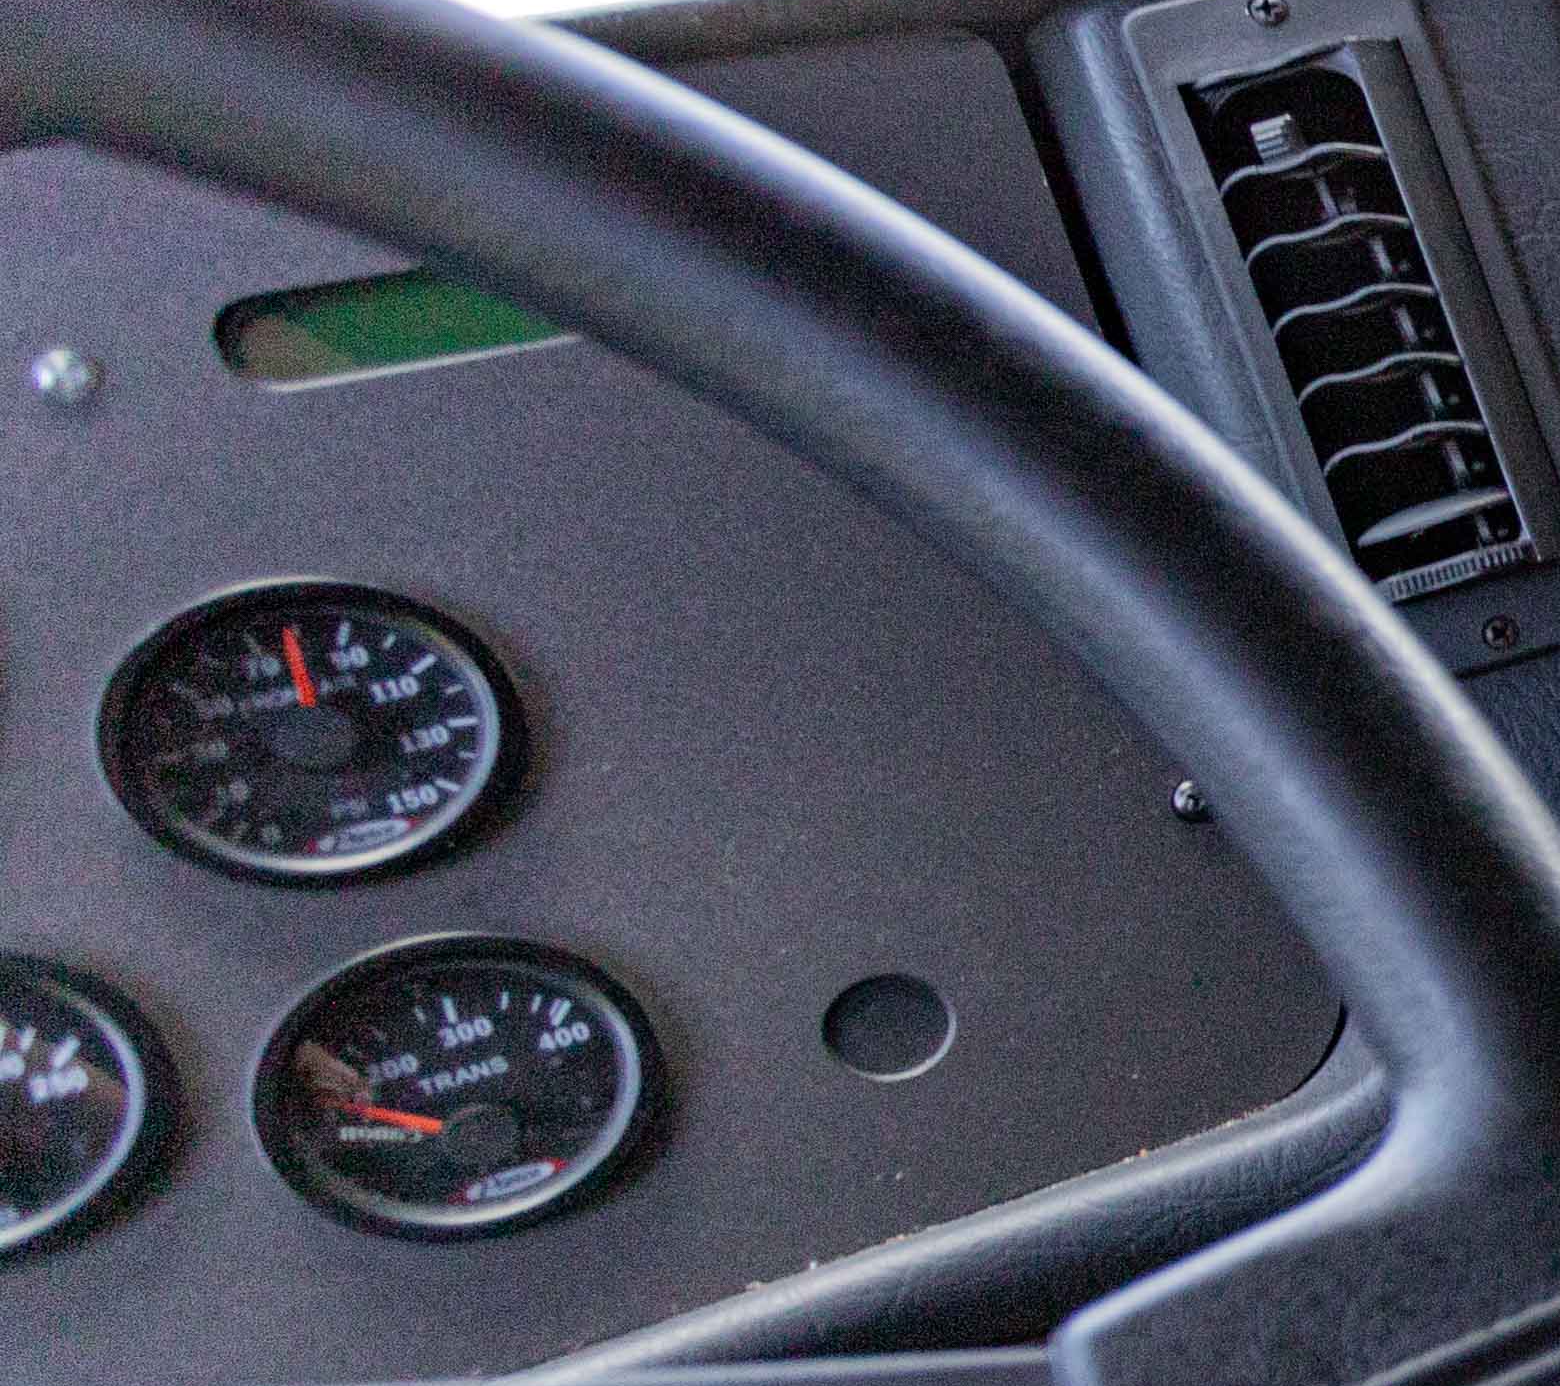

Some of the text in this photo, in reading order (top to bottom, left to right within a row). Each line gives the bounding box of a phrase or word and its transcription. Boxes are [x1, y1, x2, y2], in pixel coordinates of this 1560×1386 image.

[369, 674, 421, 705] 110
[399, 725, 451, 754] 130
[386, 785, 440, 815] 150
[438, 1015, 494, 1050] 300
[538, 1021, 591, 1053] 400
[417, 1054, 510, 1097] TRANS
